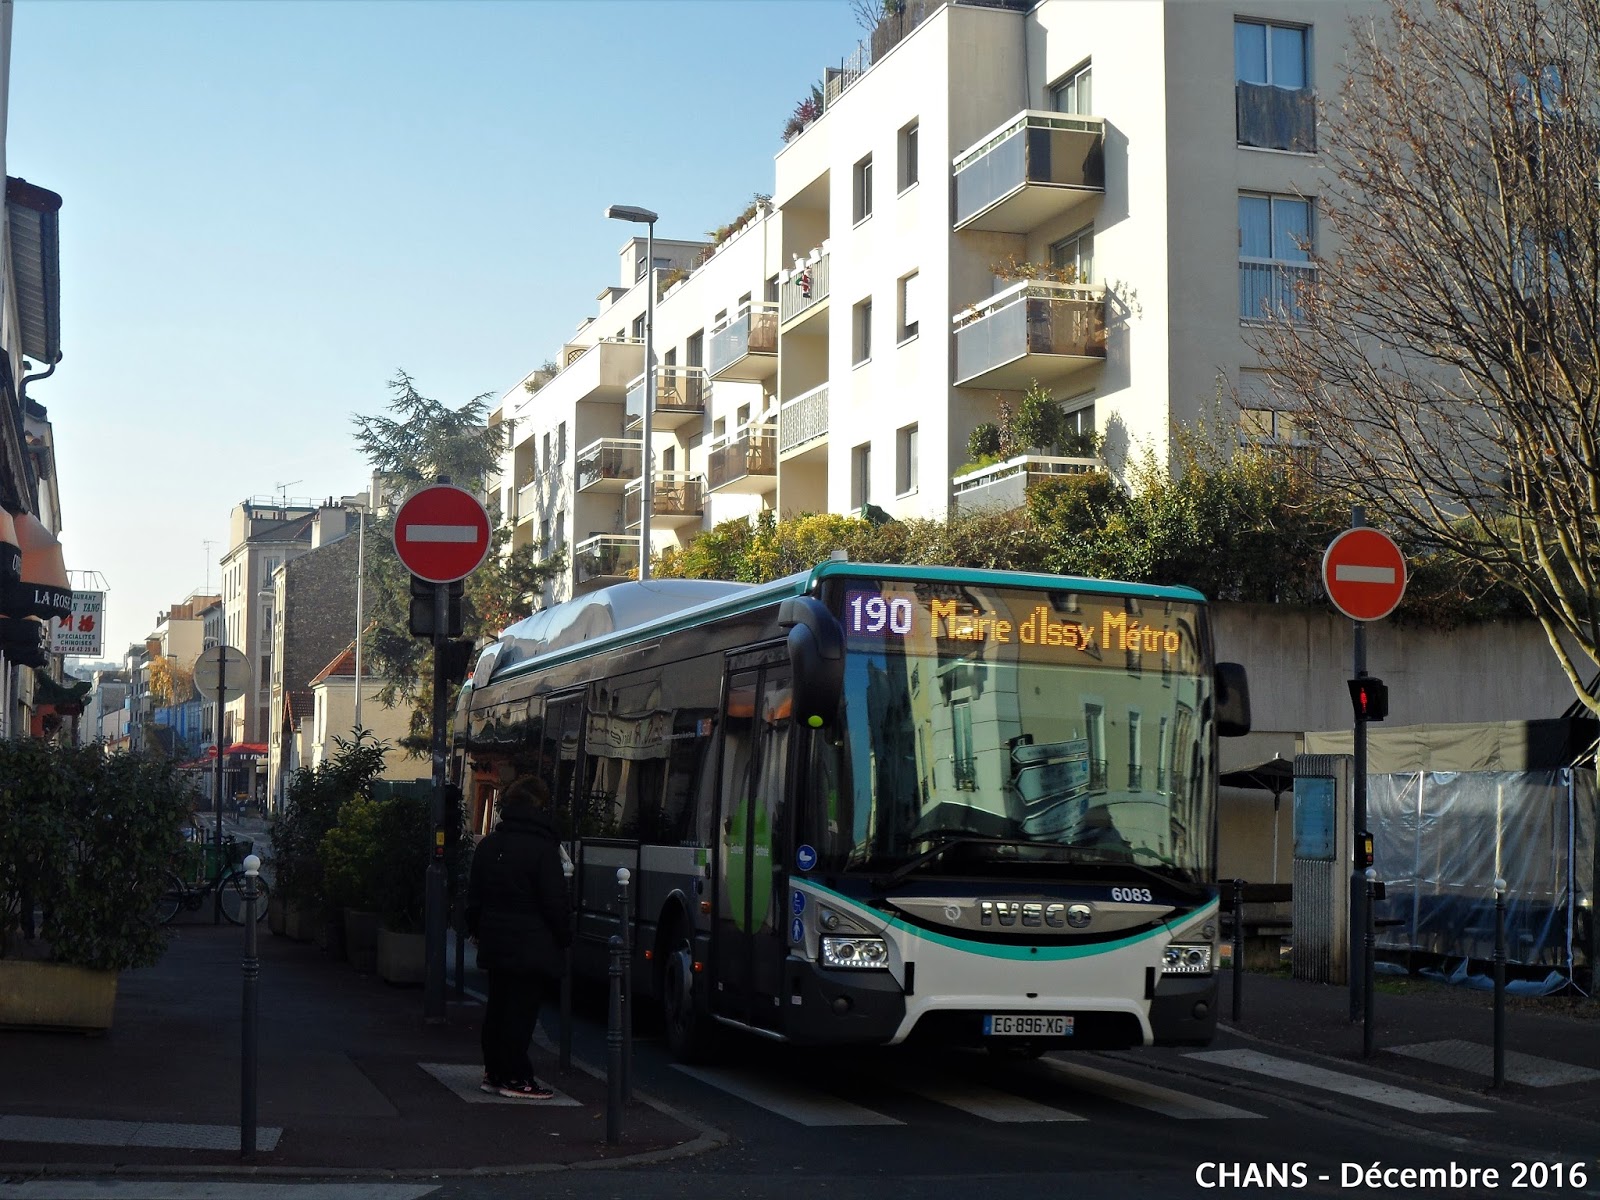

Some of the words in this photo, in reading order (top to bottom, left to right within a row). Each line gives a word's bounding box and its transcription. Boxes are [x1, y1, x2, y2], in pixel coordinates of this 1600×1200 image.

[34, 589, 50, 605] LA
[73, 593, 96, 601] AURANT
[851, 596, 912, 635] 190
[930, 598, 1013, 643] Mairie
[1019, 606, 1095, 651] d'Issy
[1102, 610, 1179, 653] Métro
[1111, 887, 1153, 903] 6083
[979, 901, 1093, 929] IVECO
[994, 1017, 1064, 1034] EG-896-XG
